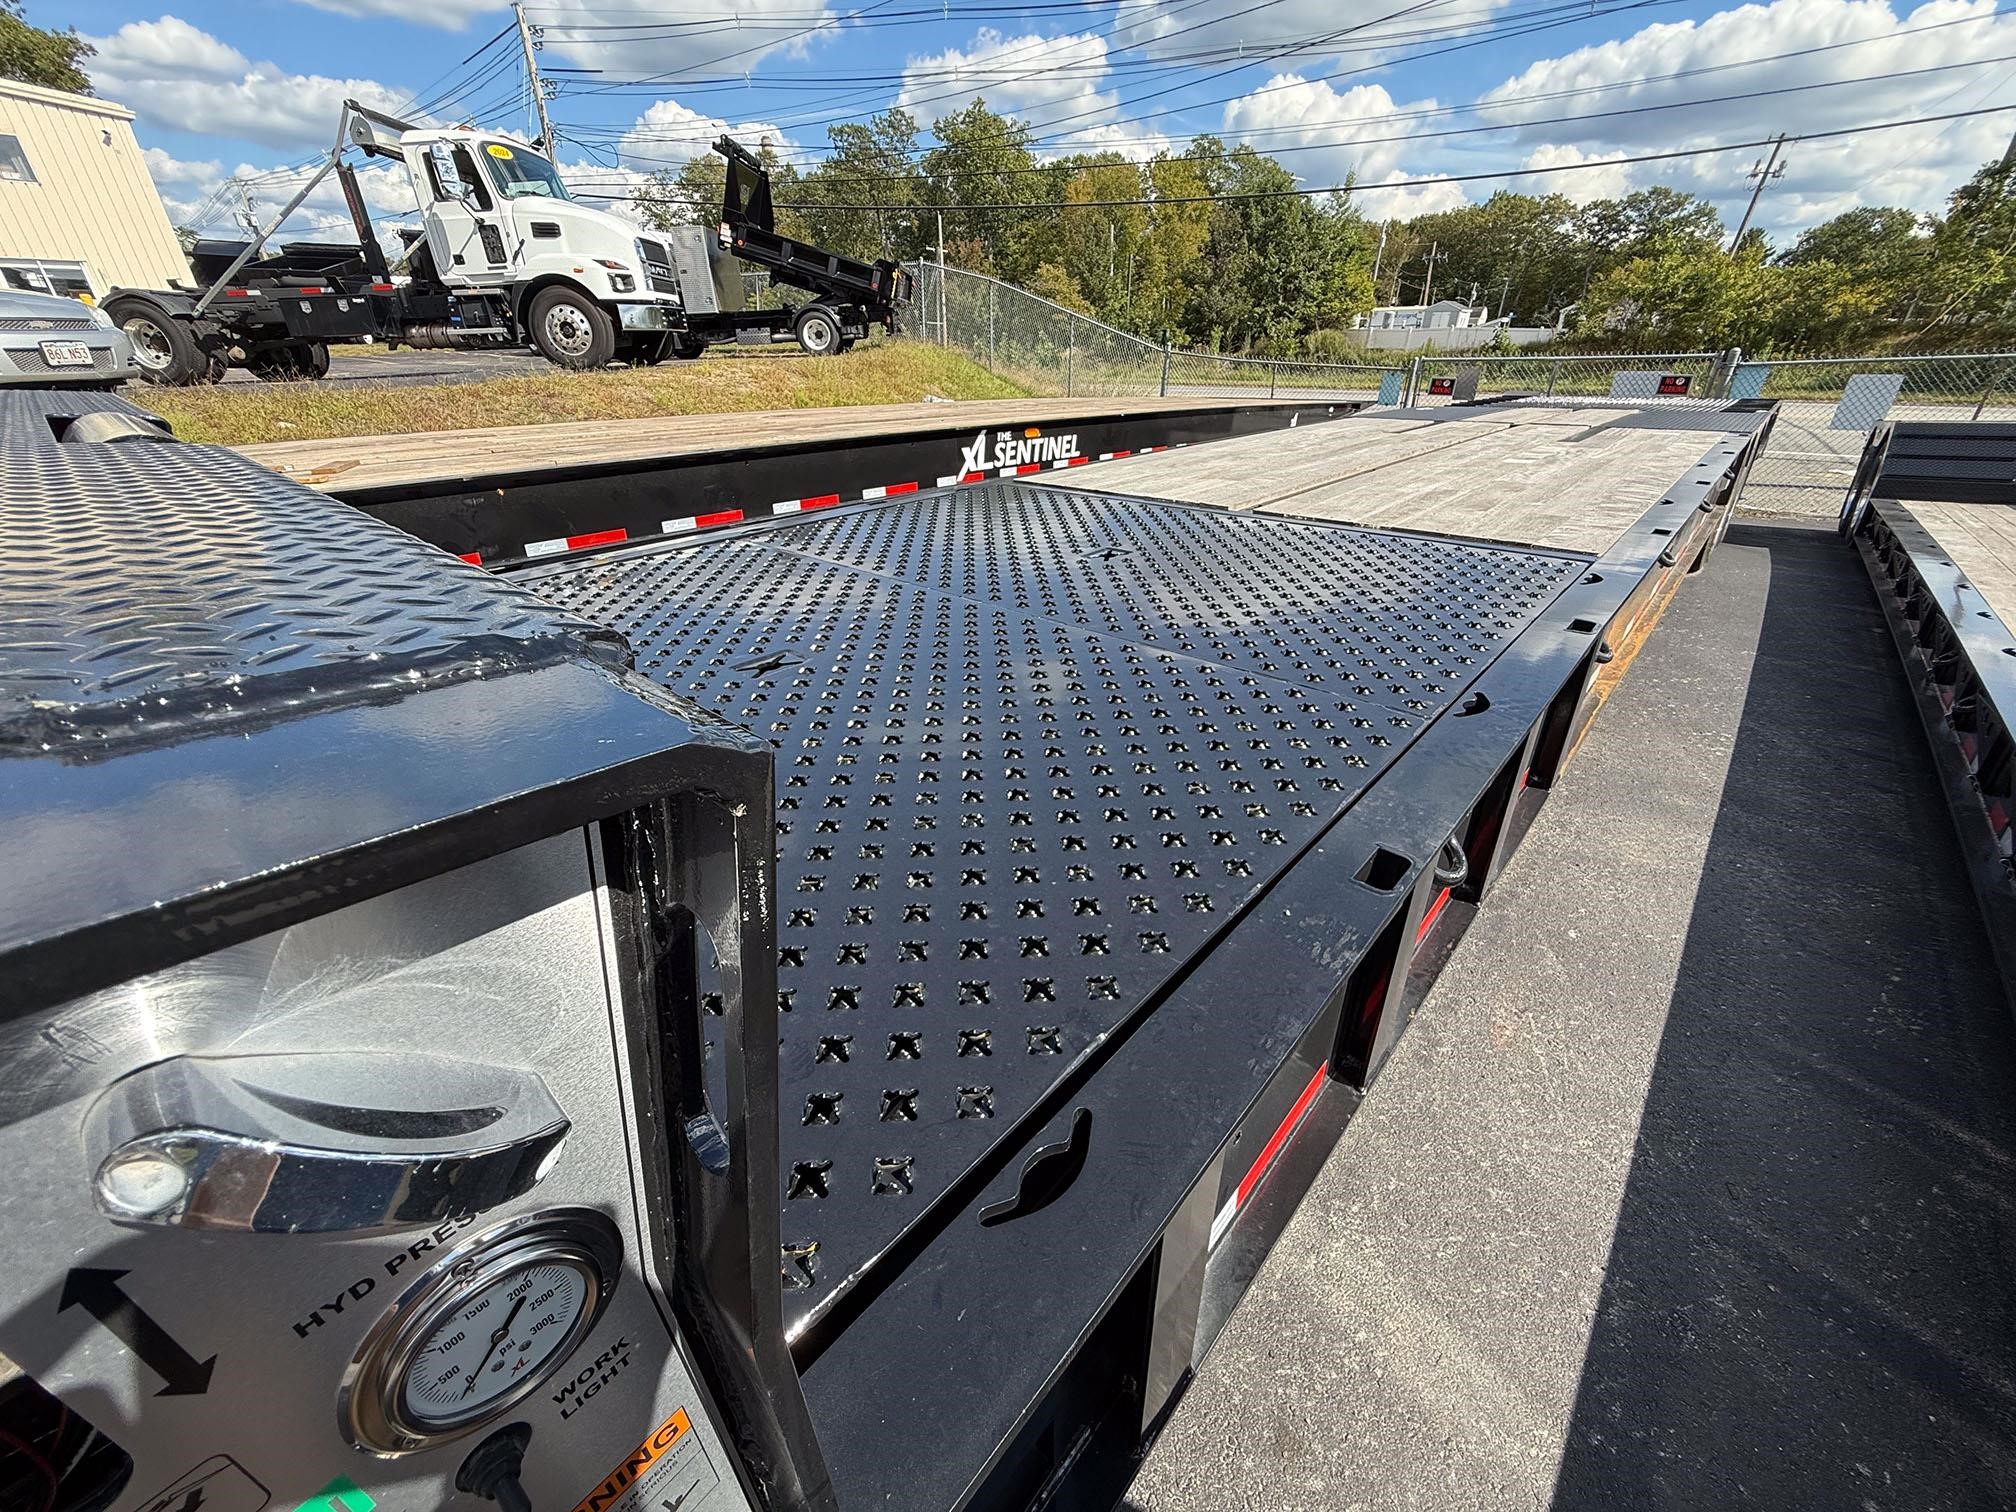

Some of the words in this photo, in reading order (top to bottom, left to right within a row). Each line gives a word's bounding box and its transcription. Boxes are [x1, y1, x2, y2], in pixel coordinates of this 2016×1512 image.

[47, 348, 68, 360] 86L
[68, 347, 89, 359] N53
[1660, 385, 1687, 393] PARKING
[1665, 377, 1675, 385] NO
[997, 431, 1012, 441] THE
[956, 429, 994, 482] XL
[994, 434, 1081, 468] SENTINEL
[291, 1277, 376, 1339] HYD
[384, 1207, 488, 1277] PRES
[506, 1279, 534, 1302] 2000
[528, 1290, 555, 1312] 2500
[463, 1299, 490, 1321] 1500
[529, 1313, 556, 1336] 3000
[436, 1331, 466, 1355] 1000
[498, 1338, 517, 1357] psi
[438, 1364, 461, 1385] 500
[464, 1374, 474, 1385] 0
[551, 1335, 631, 1405] WORK
[559, 1351, 631, 1421] LIGHT
[578, 1421, 680, 1512] NING
[640, 1437, 692, 1490] OPERATION
